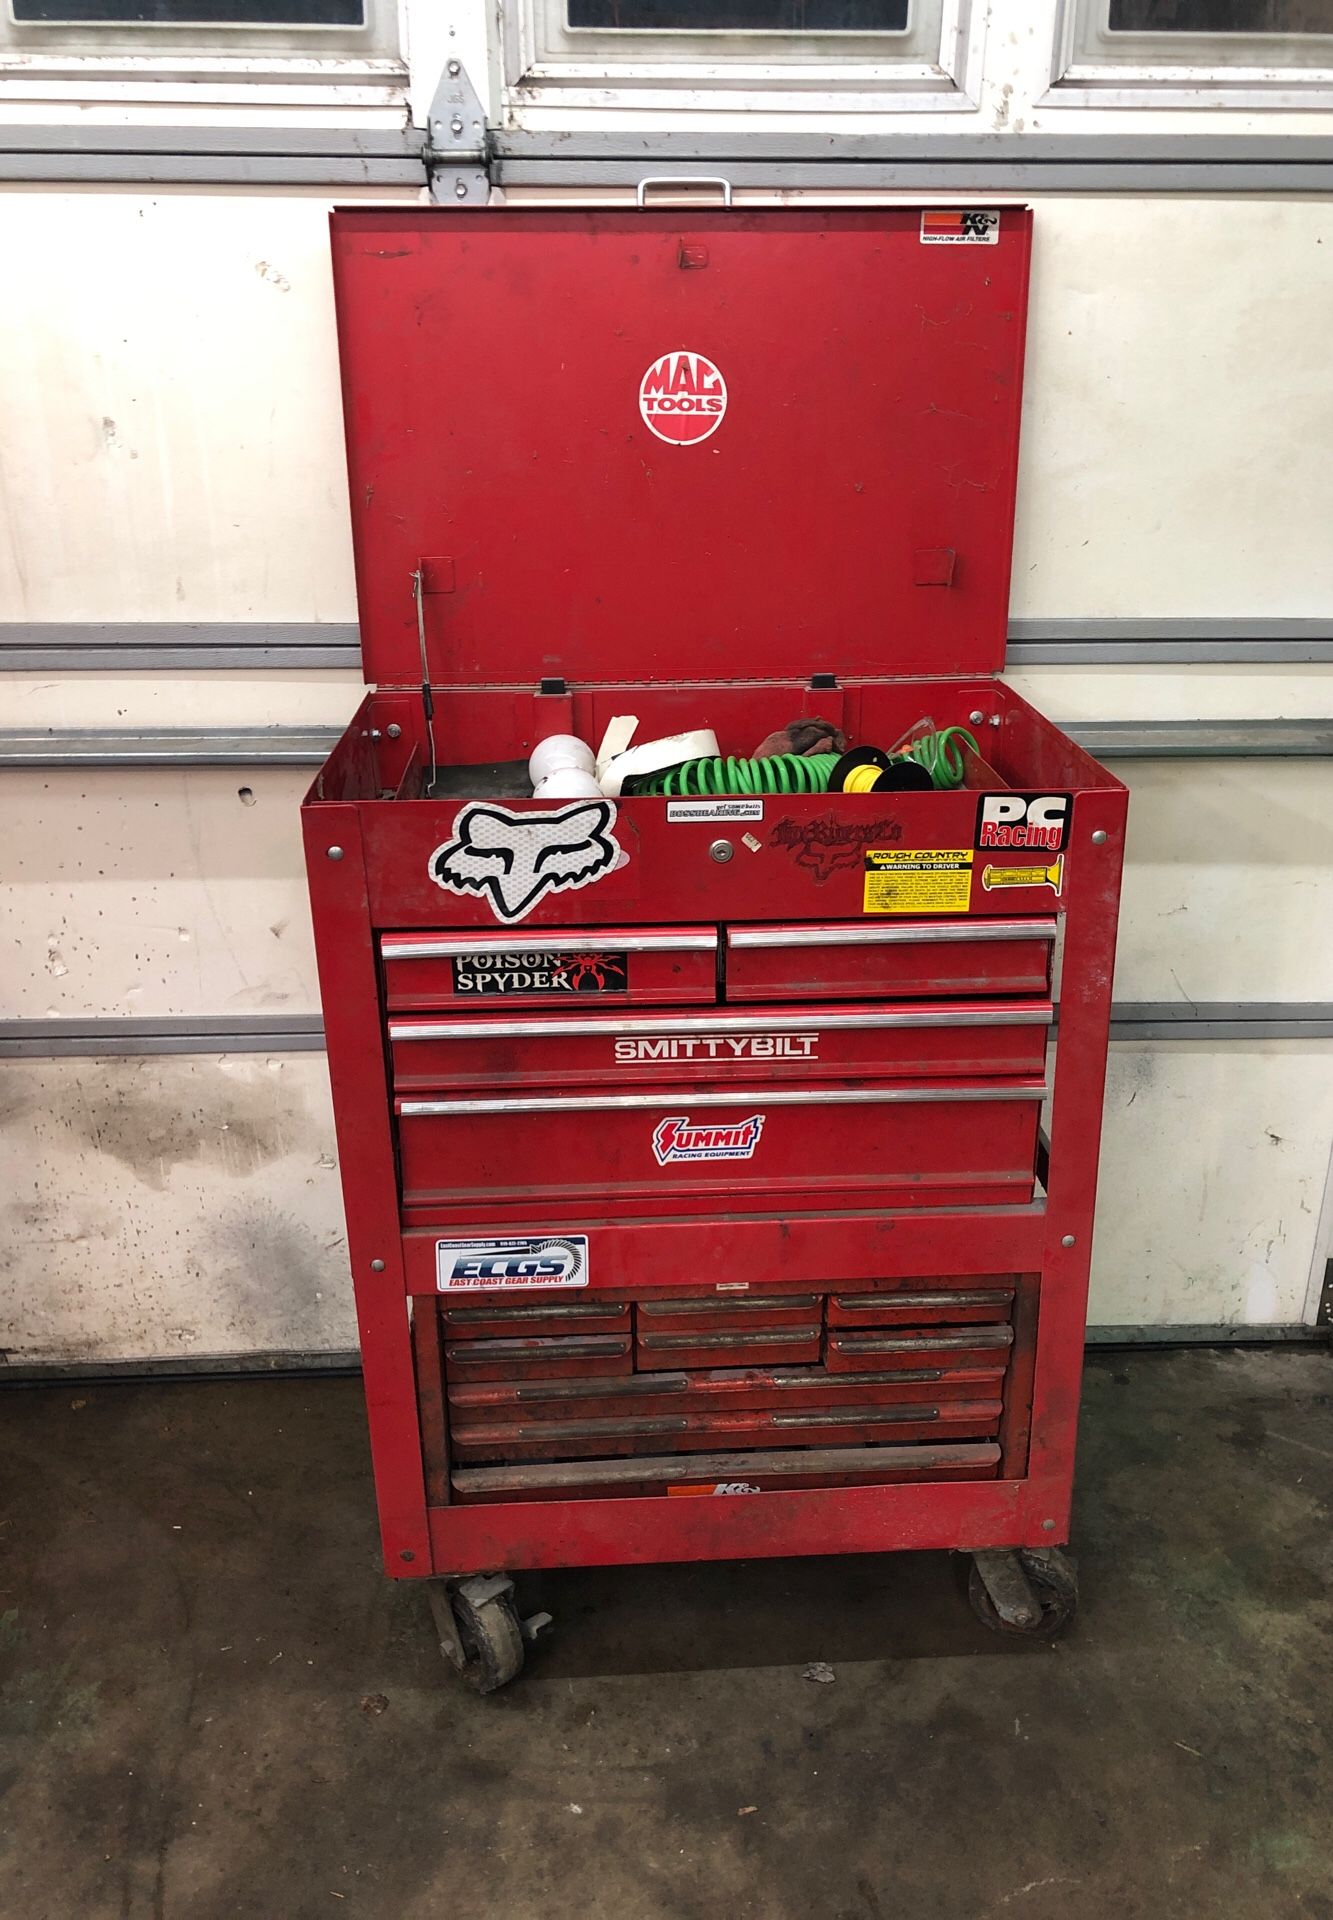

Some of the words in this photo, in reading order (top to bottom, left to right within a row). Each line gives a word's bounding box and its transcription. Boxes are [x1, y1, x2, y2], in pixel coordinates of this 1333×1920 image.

[643, 355, 723, 395] MAC
[643, 398, 723, 412] TOOLS
[983, 797, 1067, 831] PC
[980, 821, 1063, 850] Racing
[456, 953, 562, 972] POISON
[457, 971, 573, 993] SPYDER
[615, 1037, 819, 1059] SMITTYBILT
[451, 1255, 568, 1279] ECGS
[473, 1278, 503, 1286] COAST
[530, 1275, 564, 1283] SUPPLY
